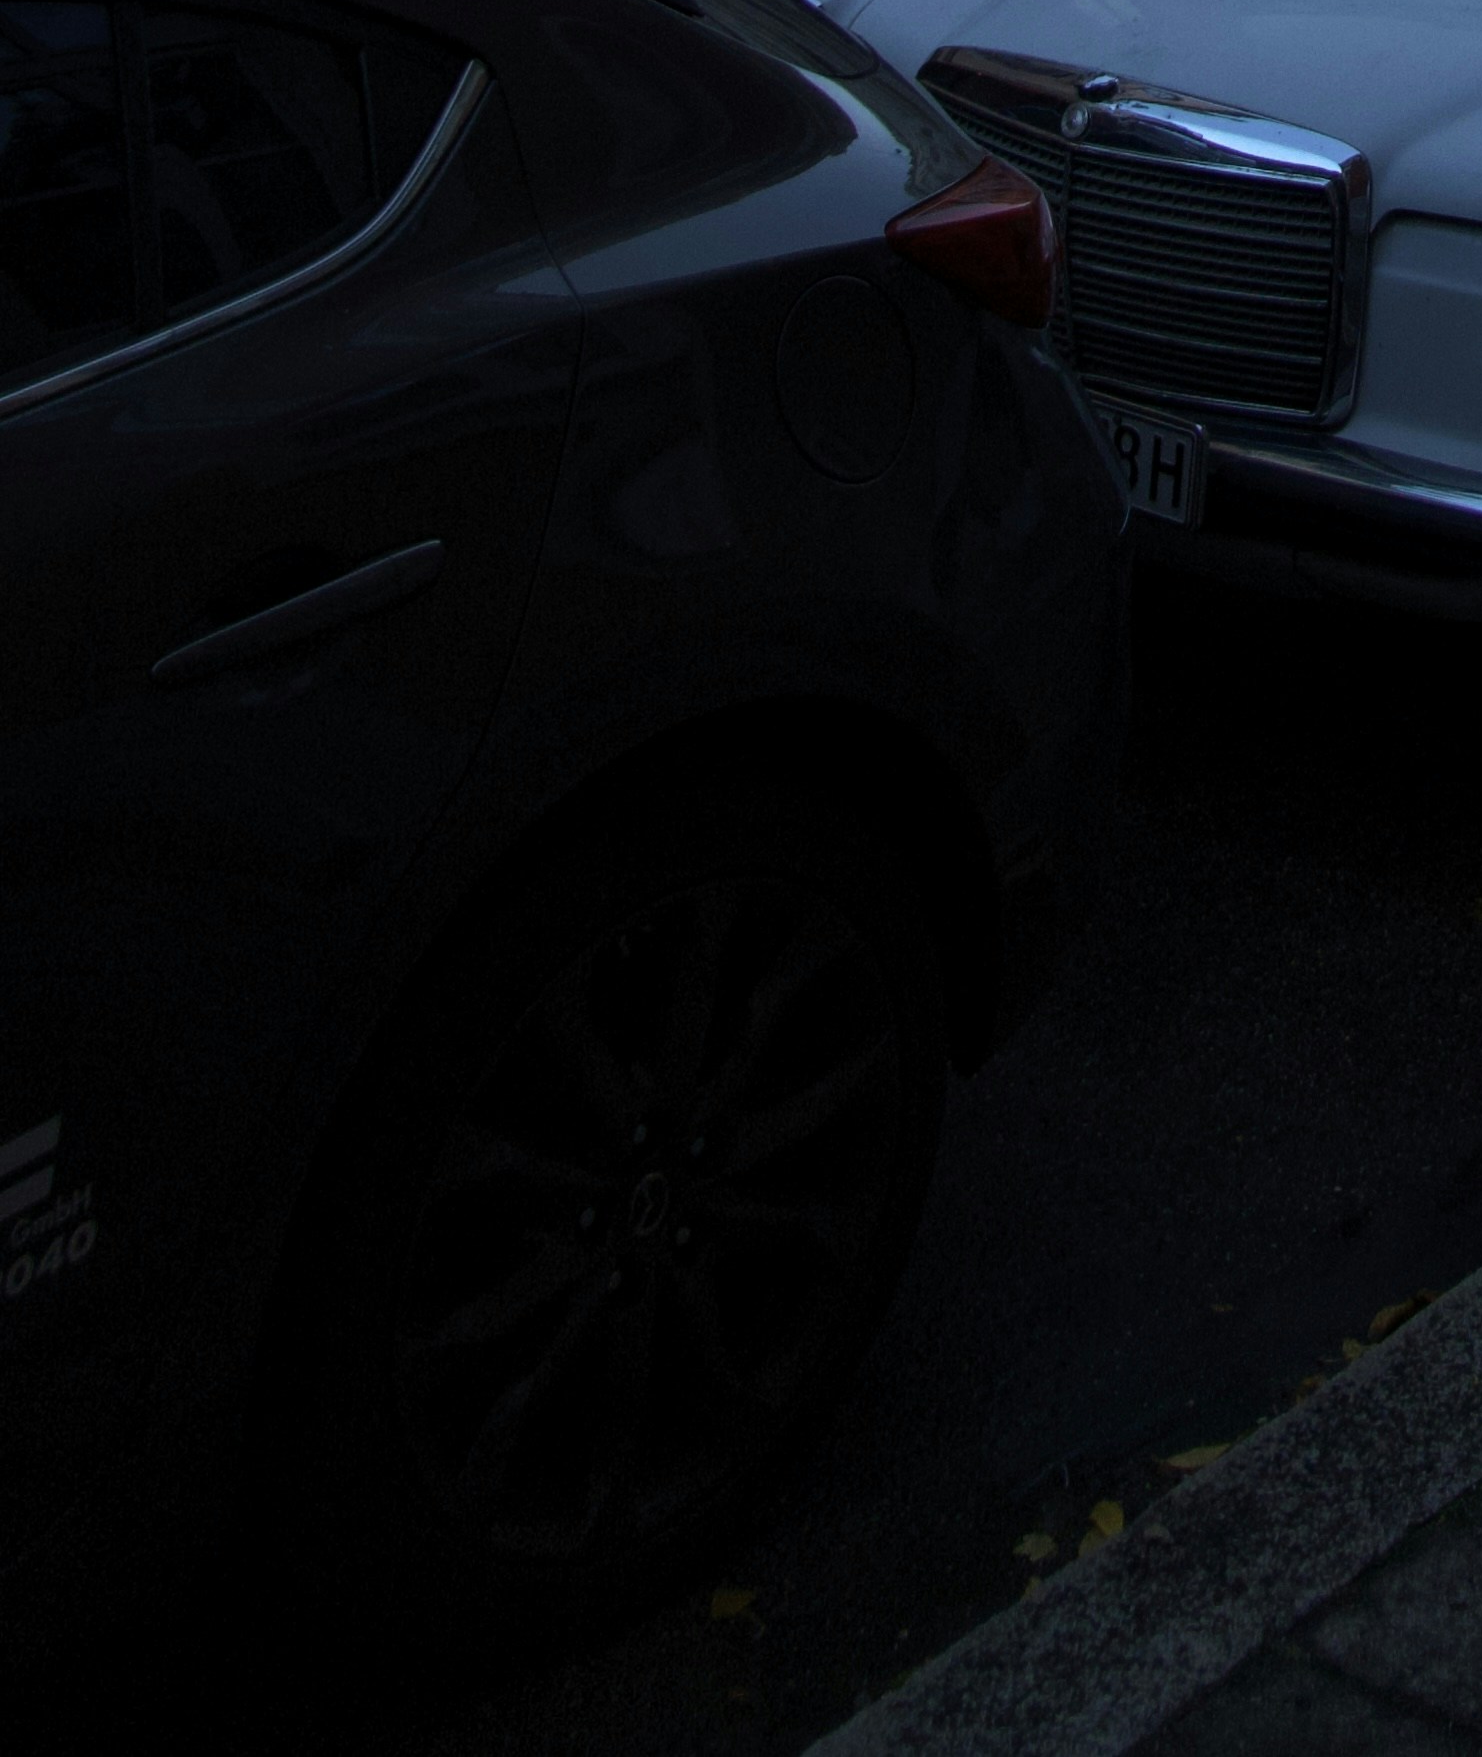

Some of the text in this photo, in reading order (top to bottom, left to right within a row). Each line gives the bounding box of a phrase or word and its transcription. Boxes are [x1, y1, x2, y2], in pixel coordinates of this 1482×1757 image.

[1098, 417, 1185, 509] 8H
[10, 1182, 94, 1247] GmbH
[0, 1219, 97, 1296] 040
